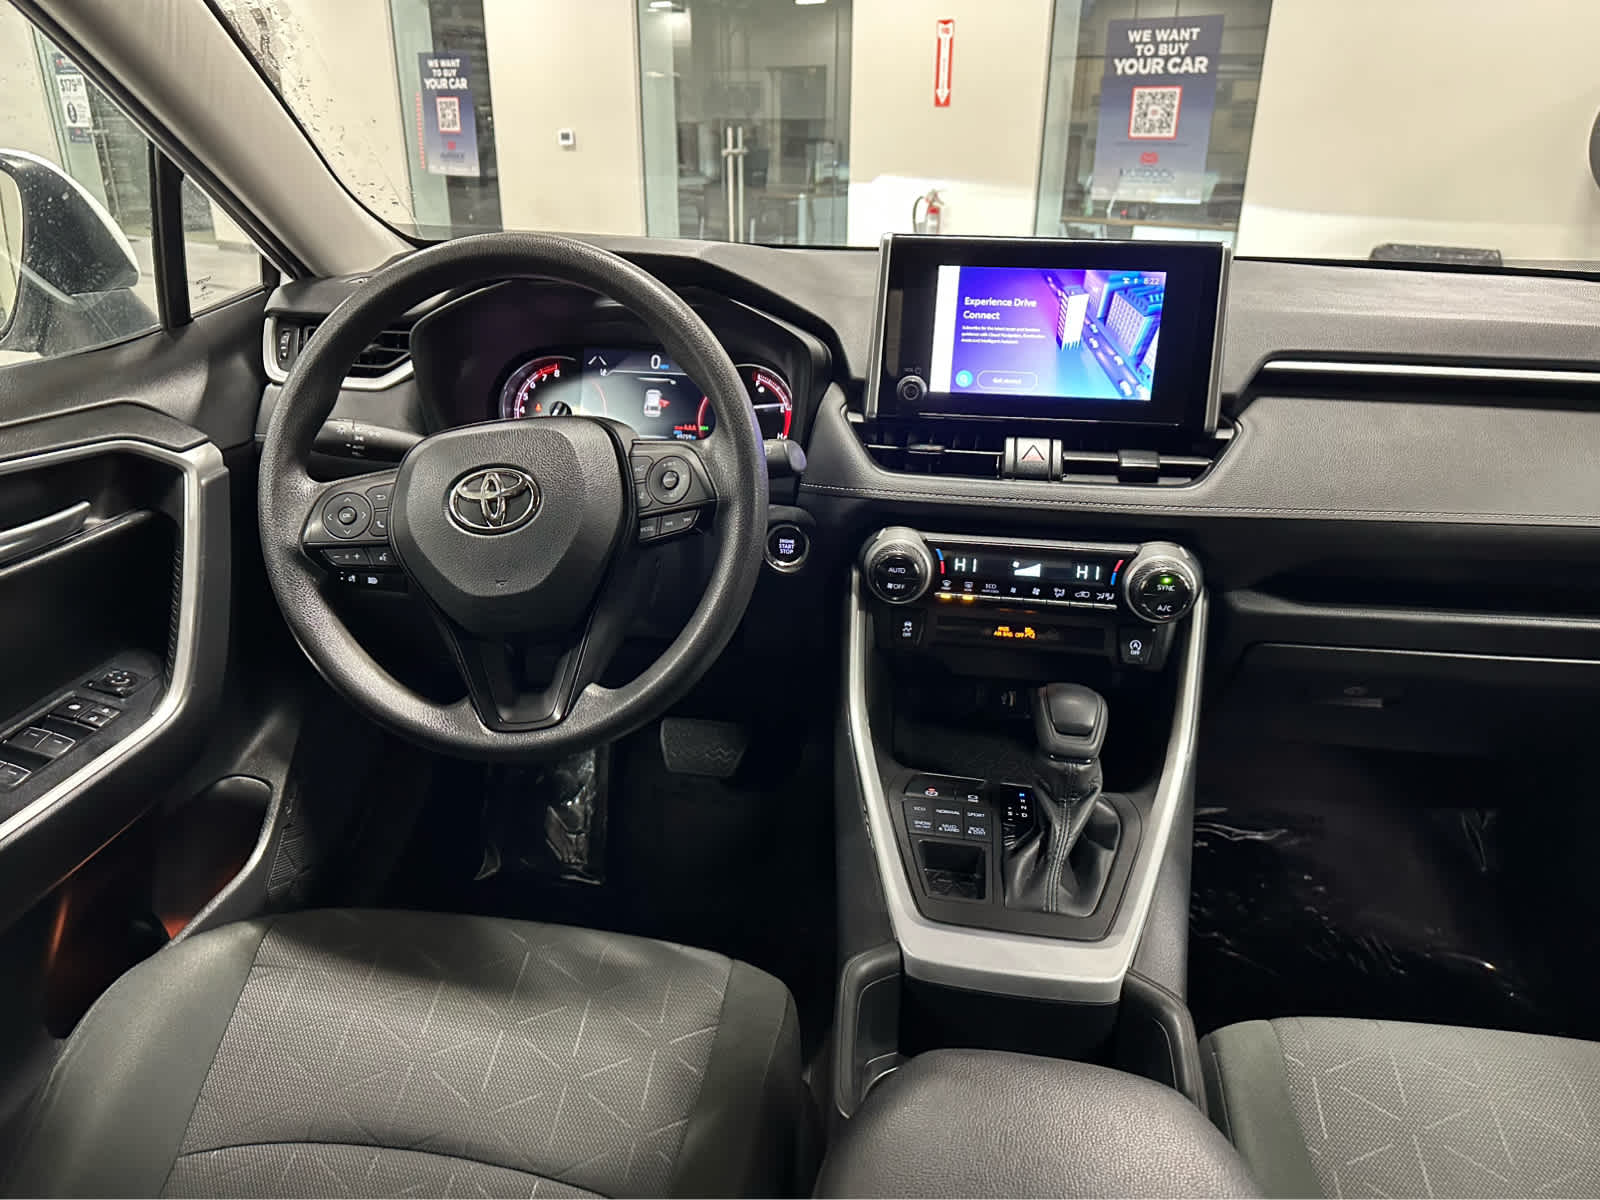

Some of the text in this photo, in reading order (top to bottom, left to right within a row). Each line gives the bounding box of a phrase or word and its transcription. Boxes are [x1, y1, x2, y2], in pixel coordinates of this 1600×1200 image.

[1128, 28, 1200, 42] WE WANT
[1135, 43, 1189, 56] TO BUY
[427, 59, 460, 68] WE WANT
[1114, 57, 1208, 75] YOUR CAR
[432, 69, 456, 77] TO BUY
[424, 78, 468, 90] YOUR CAR
[964, 296, 1037, 307] Experience Drive
[963, 310, 1000, 320] Connect
[651, 354, 661, 370] 0
[541, 373, 548, 382] 7
[554, 369, 560, 378] 8
[1157, 604, 1172, 612] A/C
